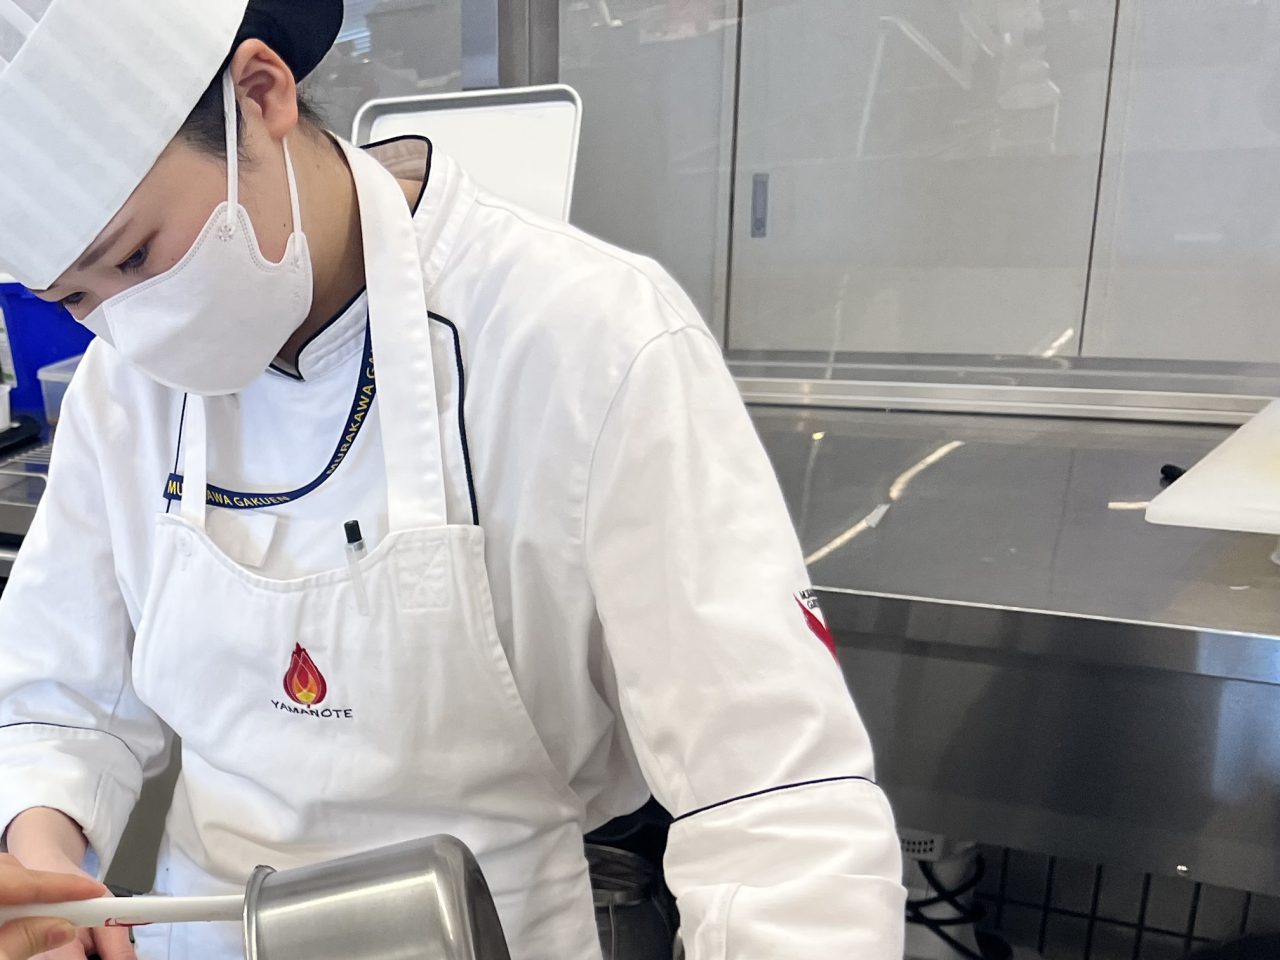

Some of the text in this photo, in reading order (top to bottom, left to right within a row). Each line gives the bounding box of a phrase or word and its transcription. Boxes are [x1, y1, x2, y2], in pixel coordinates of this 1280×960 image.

[326, 384, 375, 475] MURAKAWA
[233, 496, 290, 507] GAKUEN
[271, 699, 353, 719] YAMANOTE
